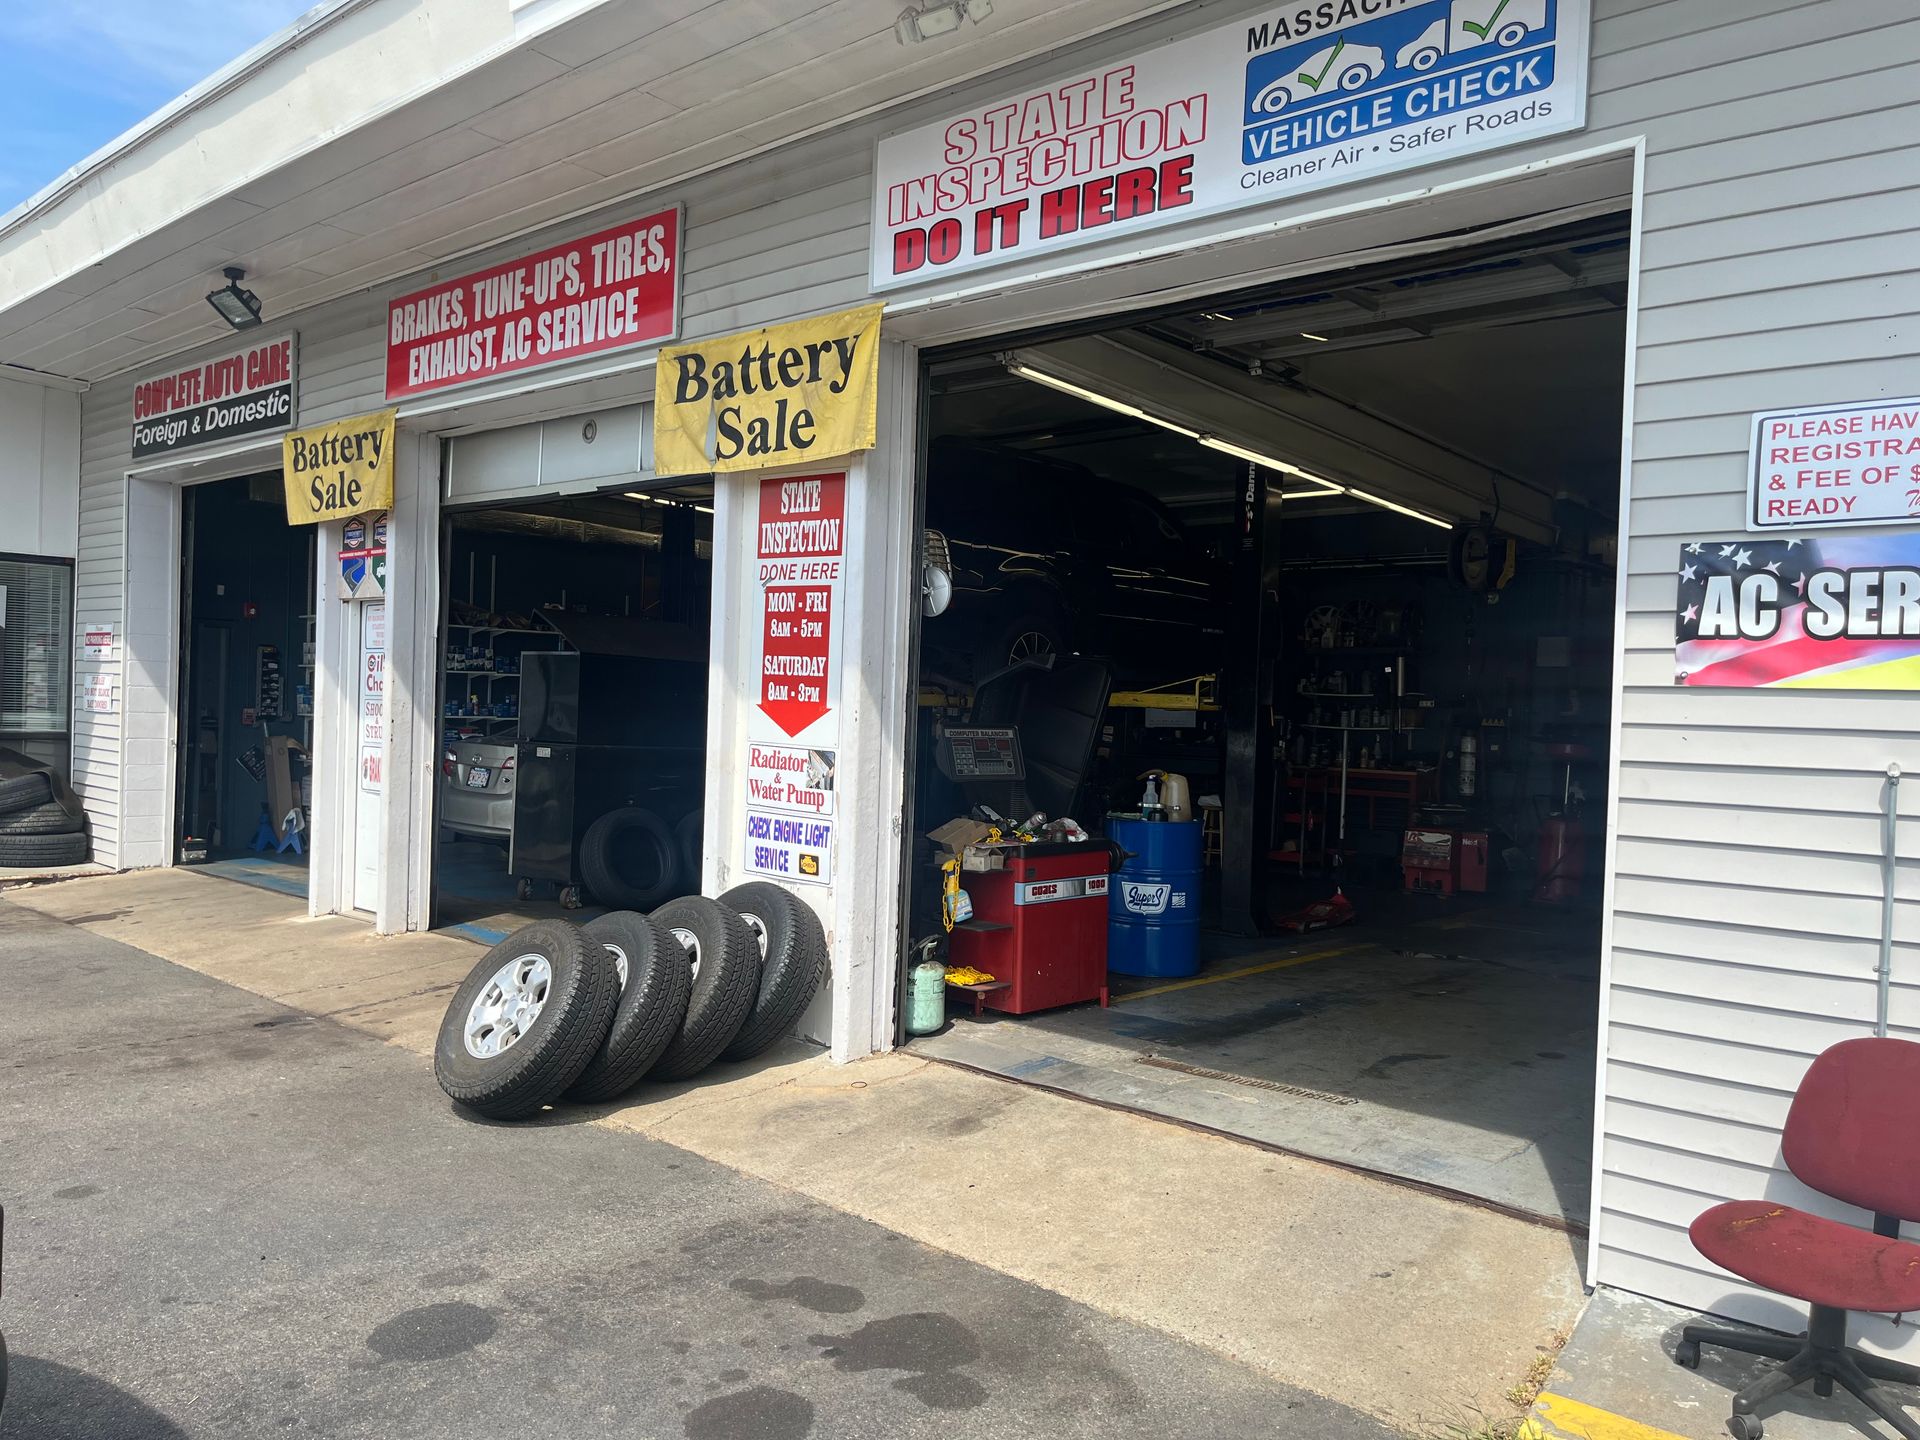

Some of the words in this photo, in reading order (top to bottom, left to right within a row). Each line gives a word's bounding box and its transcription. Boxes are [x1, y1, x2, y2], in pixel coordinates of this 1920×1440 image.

[1247, 0, 1405, 52] MASSAC
[945, 64, 1135, 165] STATE
[1248, 99, 1393, 160] VEHICLE
[1405, 55, 1544, 118] CHECK
[888, 93, 1207, 227] INSPECTION
[1240, 157, 1327, 190] Cleaner
[1331, 147, 1364, 168] Air
[1389, 123, 1457, 153] Safer
[1465, 99, 1553, 135] Roads
[893, 218, 963, 275] DO
[974, 198, 1029, 255] IT
[1039, 154, 1195, 239] HERE
[391, 287, 467, 346] BRAKES,
[473, 251, 585, 322] TUNE-UPS,
[591, 224, 671, 288] TIRES,
[408, 326, 497, 387] EXHAUST,
[501, 317, 532, 364] AC
[537, 287, 639, 355] SERVICE
[134, 368, 201, 420] COMPLETE
[203, 355, 244, 401] AUTO
[247, 340, 290, 390] CARE
[674, 334, 861, 405] Battery
[133, 418, 188, 447] Foreign
[192, 416, 201, 434] &
[205, 390, 290, 431] Domestic
[716, 399, 816, 461] Sale
[1771, 417, 1863, 440] PLEASE
[291, 429, 385, 473] Battery
[310, 470, 362, 512] Sale
[781, 480, 821, 514] STATE
[1768, 474, 1786, 491] &
[1797, 469, 1851, 489] FEE
[1861, 466, 1900, 484] OF
[1768, 496, 1857, 518] READY
[761, 519, 840, 553] INSPECTION
[760, 564, 797, 580] DONE
[800, 562, 839, 580] HERE
[767, 592, 796, 612] MON
[805, 592, 828, 612] FRI
[1697, 573, 1779, 637] AC
[770, 619, 791, 637] 8AM
[801, 619, 822, 637] 5PM
[764, 655, 826, 676] SATURDAY
[798, 683, 820, 702] 3PM
[750, 748, 807, 772] Radiator
[774, 772, 782, 784] &
[749, 779, 784, 801] Water
[786, 783, 825, 812] Pump
[748, 815, 772, 840] CHECK
[773, 819, 803, 845] ENGINE
[804, 823, 830, 848] LIGHT
[755, 845, 789, 872] SERVICE
